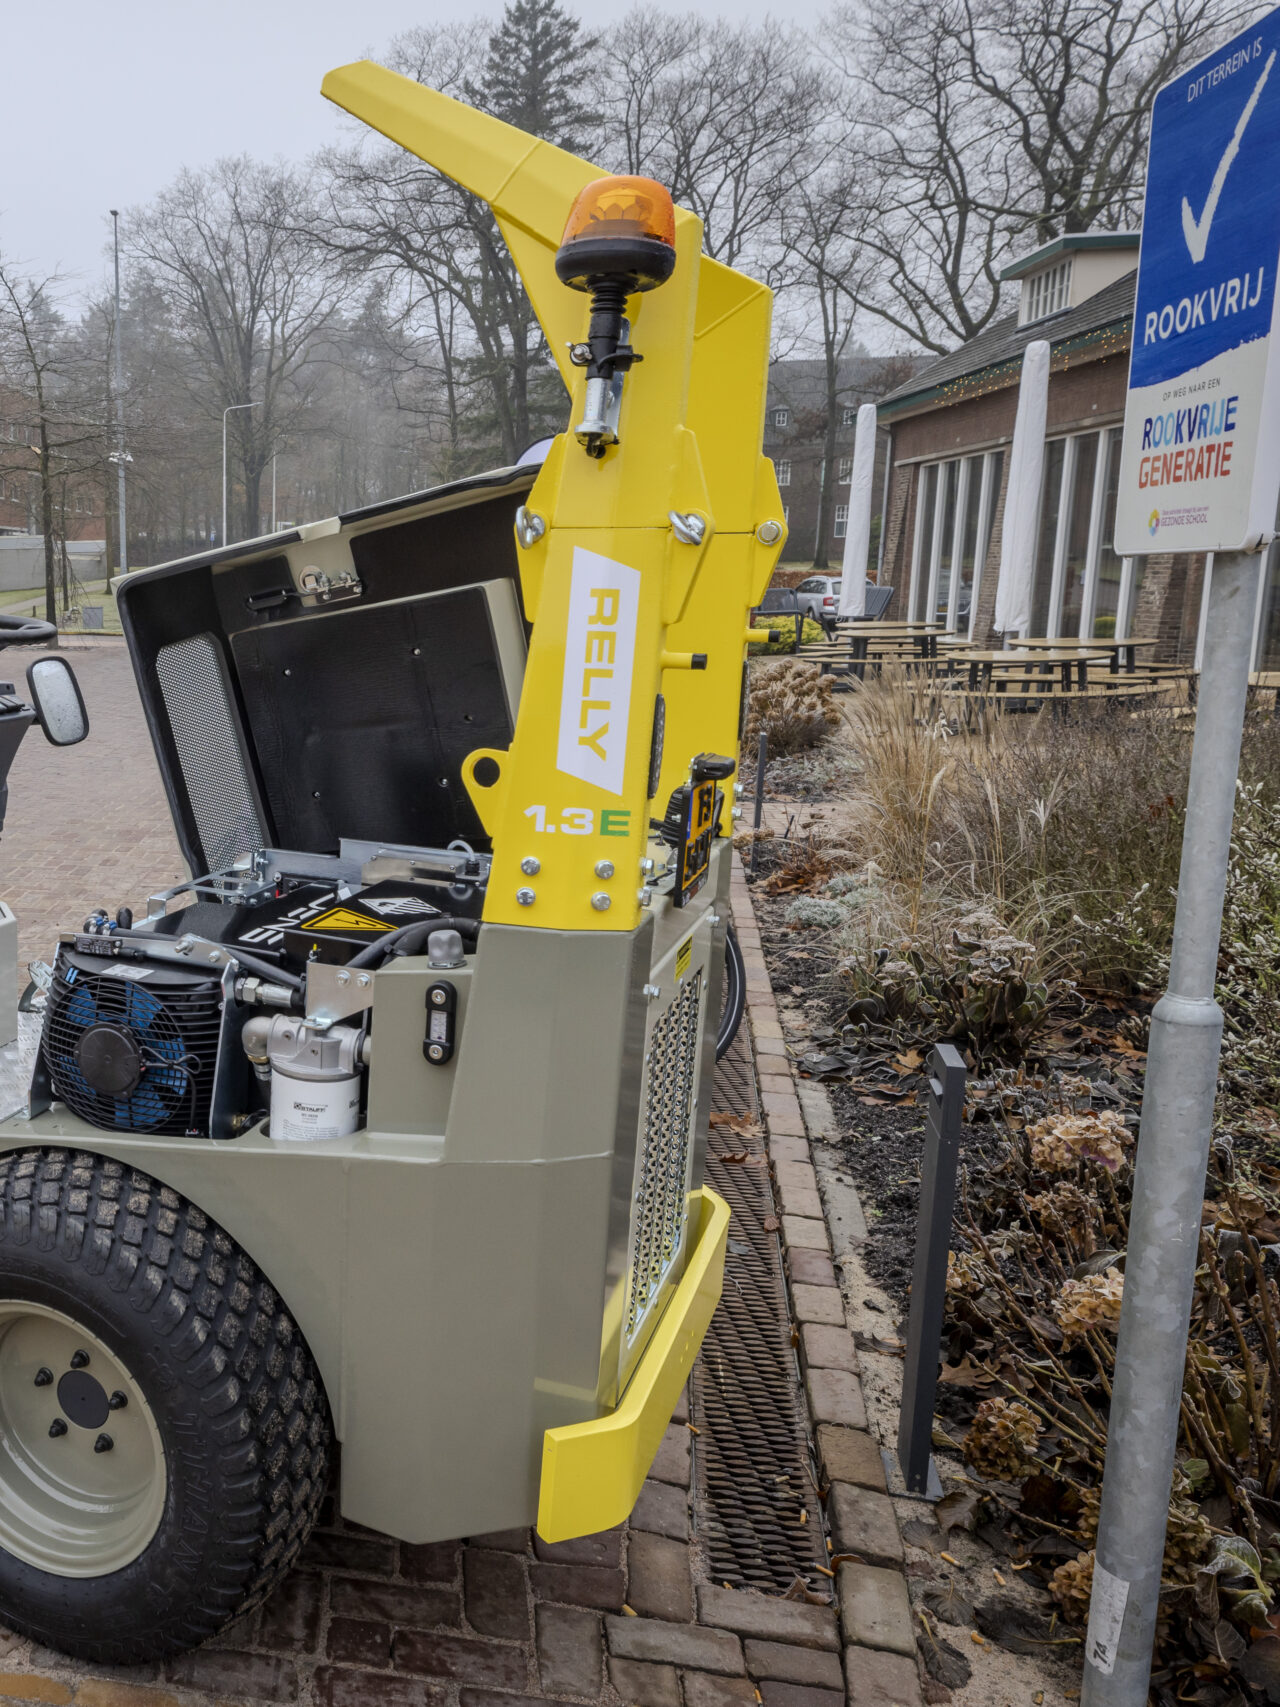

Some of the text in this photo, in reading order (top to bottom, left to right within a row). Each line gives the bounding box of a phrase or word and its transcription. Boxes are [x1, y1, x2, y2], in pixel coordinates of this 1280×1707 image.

[1187, 36, 1263, 103] DIT TERREIN IS
[1144, 266, 1264, 346] ROOKVRIJ
[1163, 377, 1221, 401] OP WEG NAAR EEN
[1142, 395, 1239, 451] ROOKVRIJE
[1138, 441, 1233, 489] GENERATIE
[577, 587, 621, 762] RELLY
[523, 804, 631, 838] 1.3E
